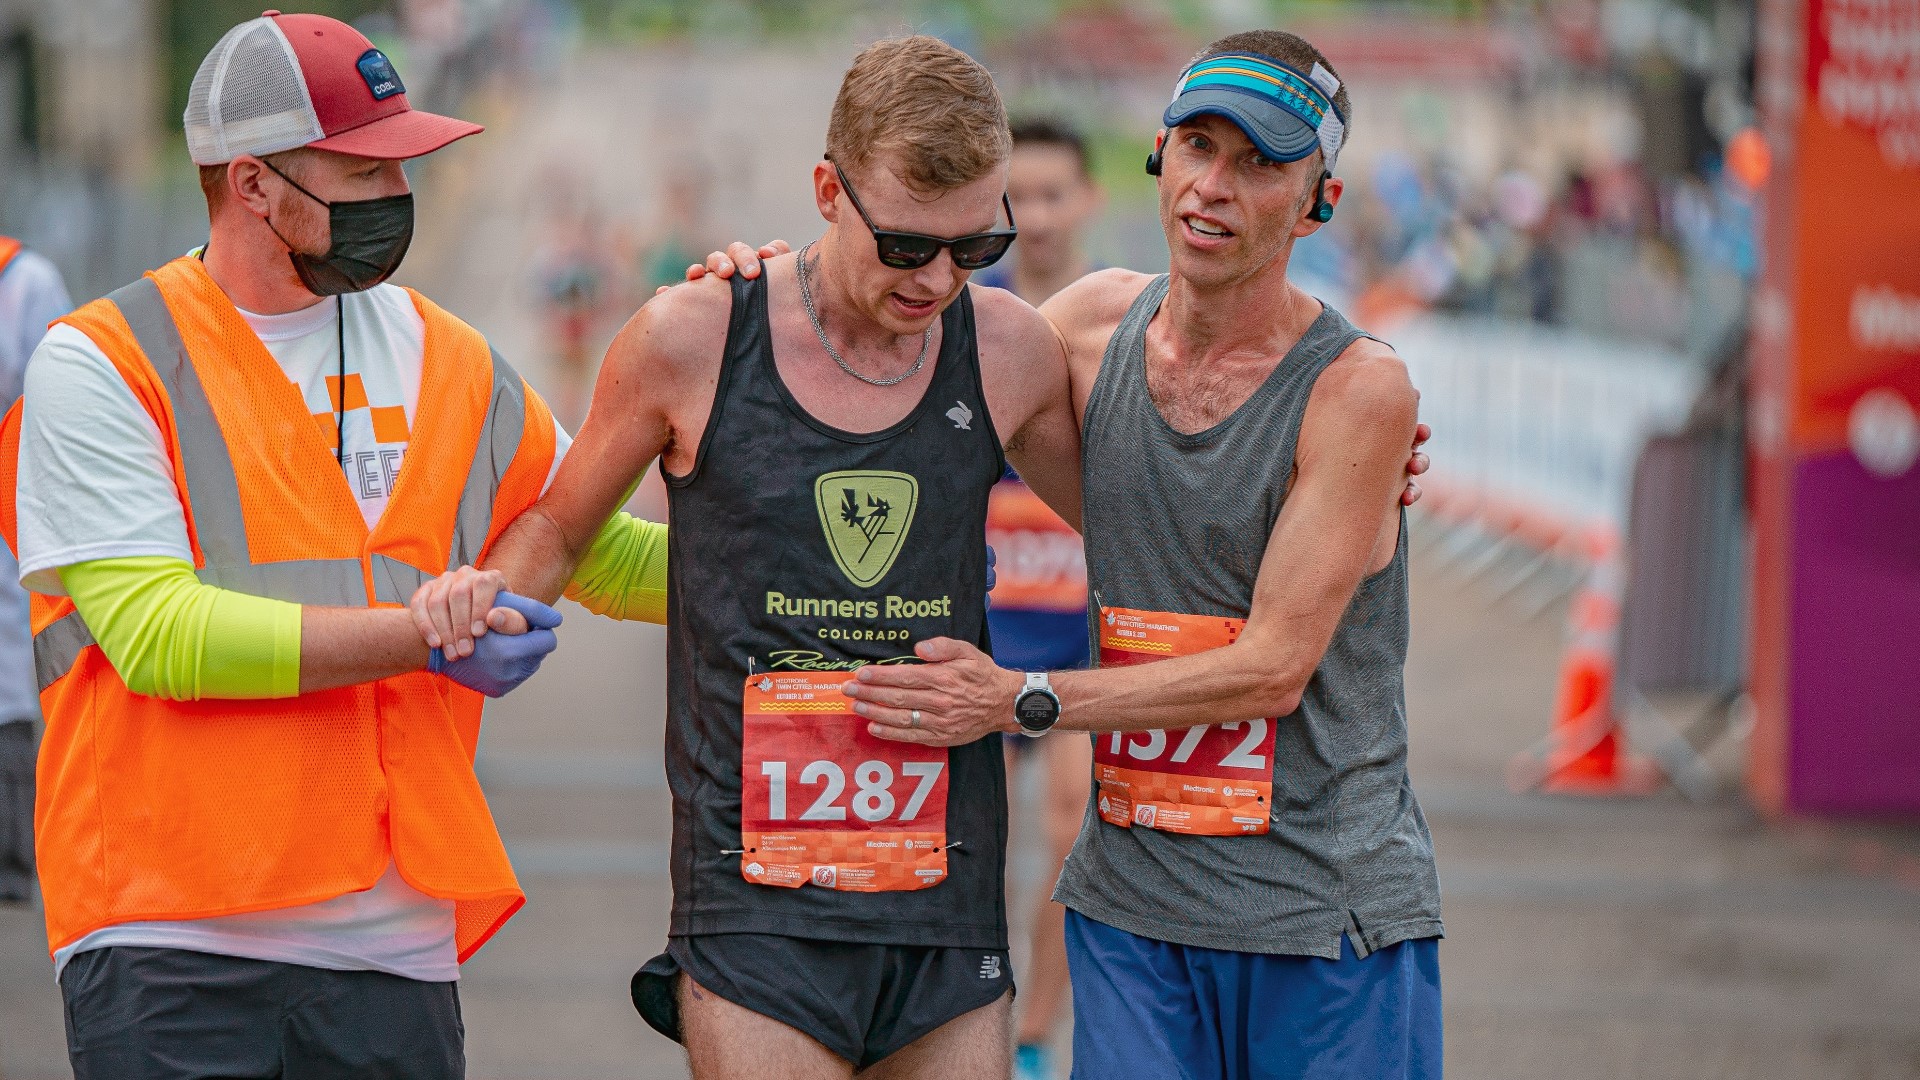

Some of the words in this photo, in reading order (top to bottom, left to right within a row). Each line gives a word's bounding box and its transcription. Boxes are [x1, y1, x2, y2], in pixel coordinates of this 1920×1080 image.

[766, 591, 878, 618] Runners
[886, 595, 950, 618] Roost
[818, 628, 909, 641] COLORADO
[769, 650, 870, 672] Racing
[761, 760, 945, 821] 1287
[1183, 785, 1216, 794] Medtronic
